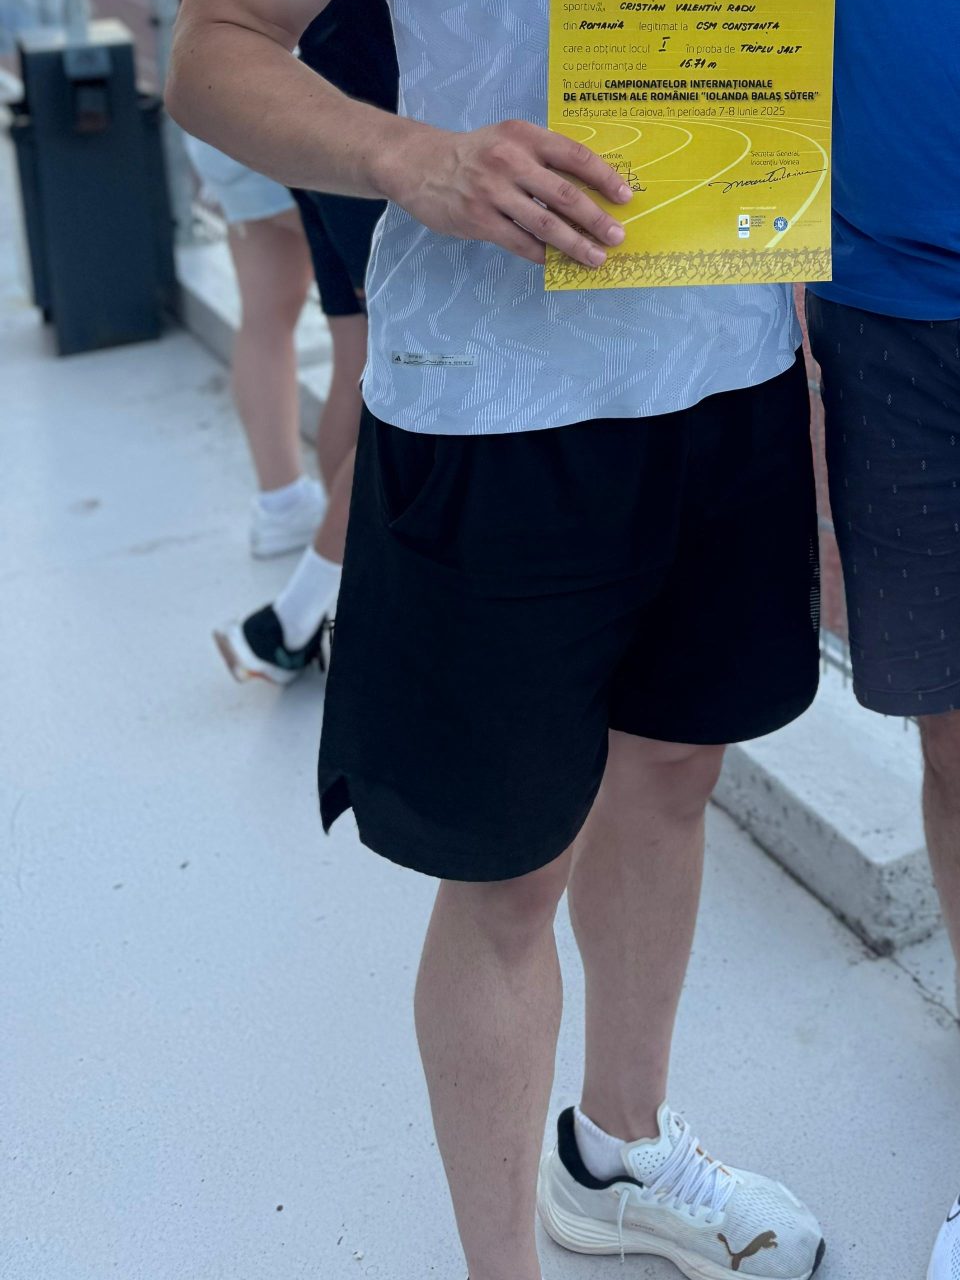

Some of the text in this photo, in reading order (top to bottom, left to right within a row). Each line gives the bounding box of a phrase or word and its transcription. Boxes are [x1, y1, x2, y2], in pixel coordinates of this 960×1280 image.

[619, 0, 666, 12] CRISTIAN
[675, 1, 722, 12] VALENTIN
[563, 21, 577, 31] din
[579, 20, 625, 30] ROMANIA
[638, 22, 689, 33] legitimat la
[696, 21, 718, 31] CSM
[562, 45, 583, 54] care
[628, 44, 651, 54] locul
[696, 45, 722, 56] proba
[724, 44, 736, 54] de
[740, 41, 774, 54] TRIPLU
[562, 62, 574, 71] cu
[635, 61, 647, 71] de
[573, 79, 602, 89] cadrul
[604, 79, 688, 89] CAMPIONATELOR
[689, 79, 773, 90] INTERNAȚIONALE
[563, 92, 577, 102] DE
[579, 92, 627, 102] ATLETISM
[629, 92, 648, 102] ALE
[650, 90, 699, 101] ROMÂNIEI
[619, 107, 628, 117] la
[629, 107, 665, 118] Craiova,
[677, 107, 717, 118] perioada
[718, 106, 736, 116] 7-8
[760, 106, 786, 116] 2025
